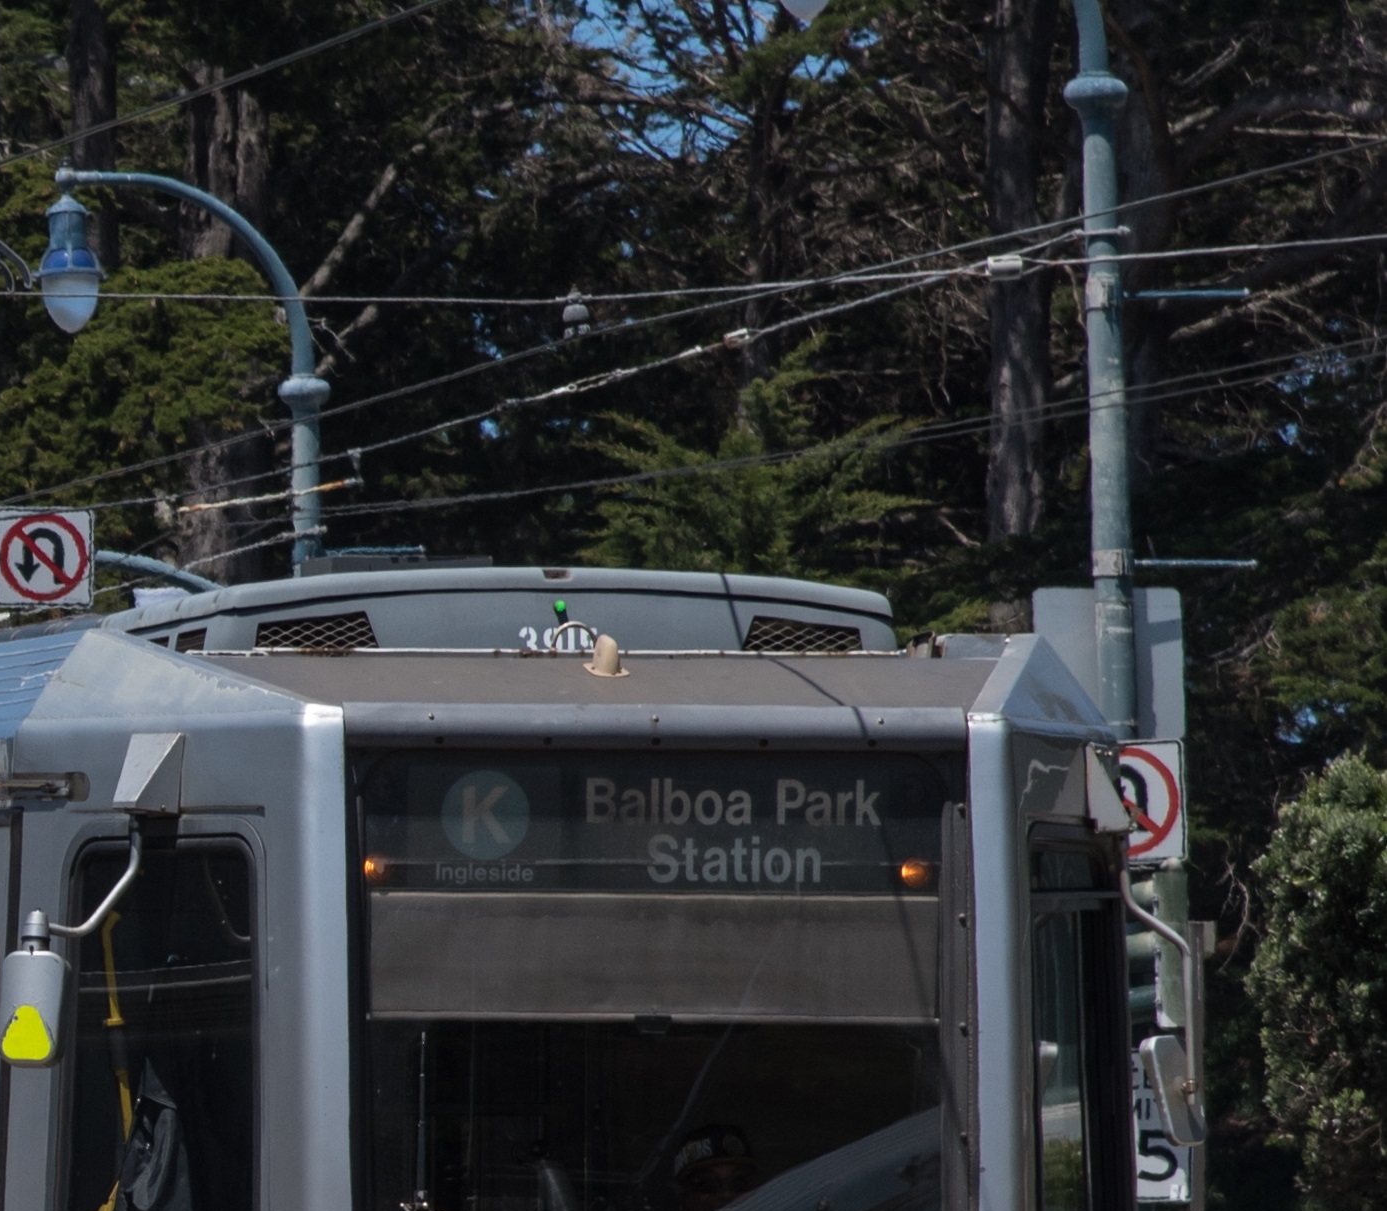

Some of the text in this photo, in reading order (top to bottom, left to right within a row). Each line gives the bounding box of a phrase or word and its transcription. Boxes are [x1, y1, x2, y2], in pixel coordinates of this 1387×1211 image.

[460, 785, 512, 844] K
[585, 776, 882, 827] Balboa Park
[435, 861, 534, 885] Ingleside
[646, 833, 822, 885] Station
[1138, 1129, 1178, 1182] 5
